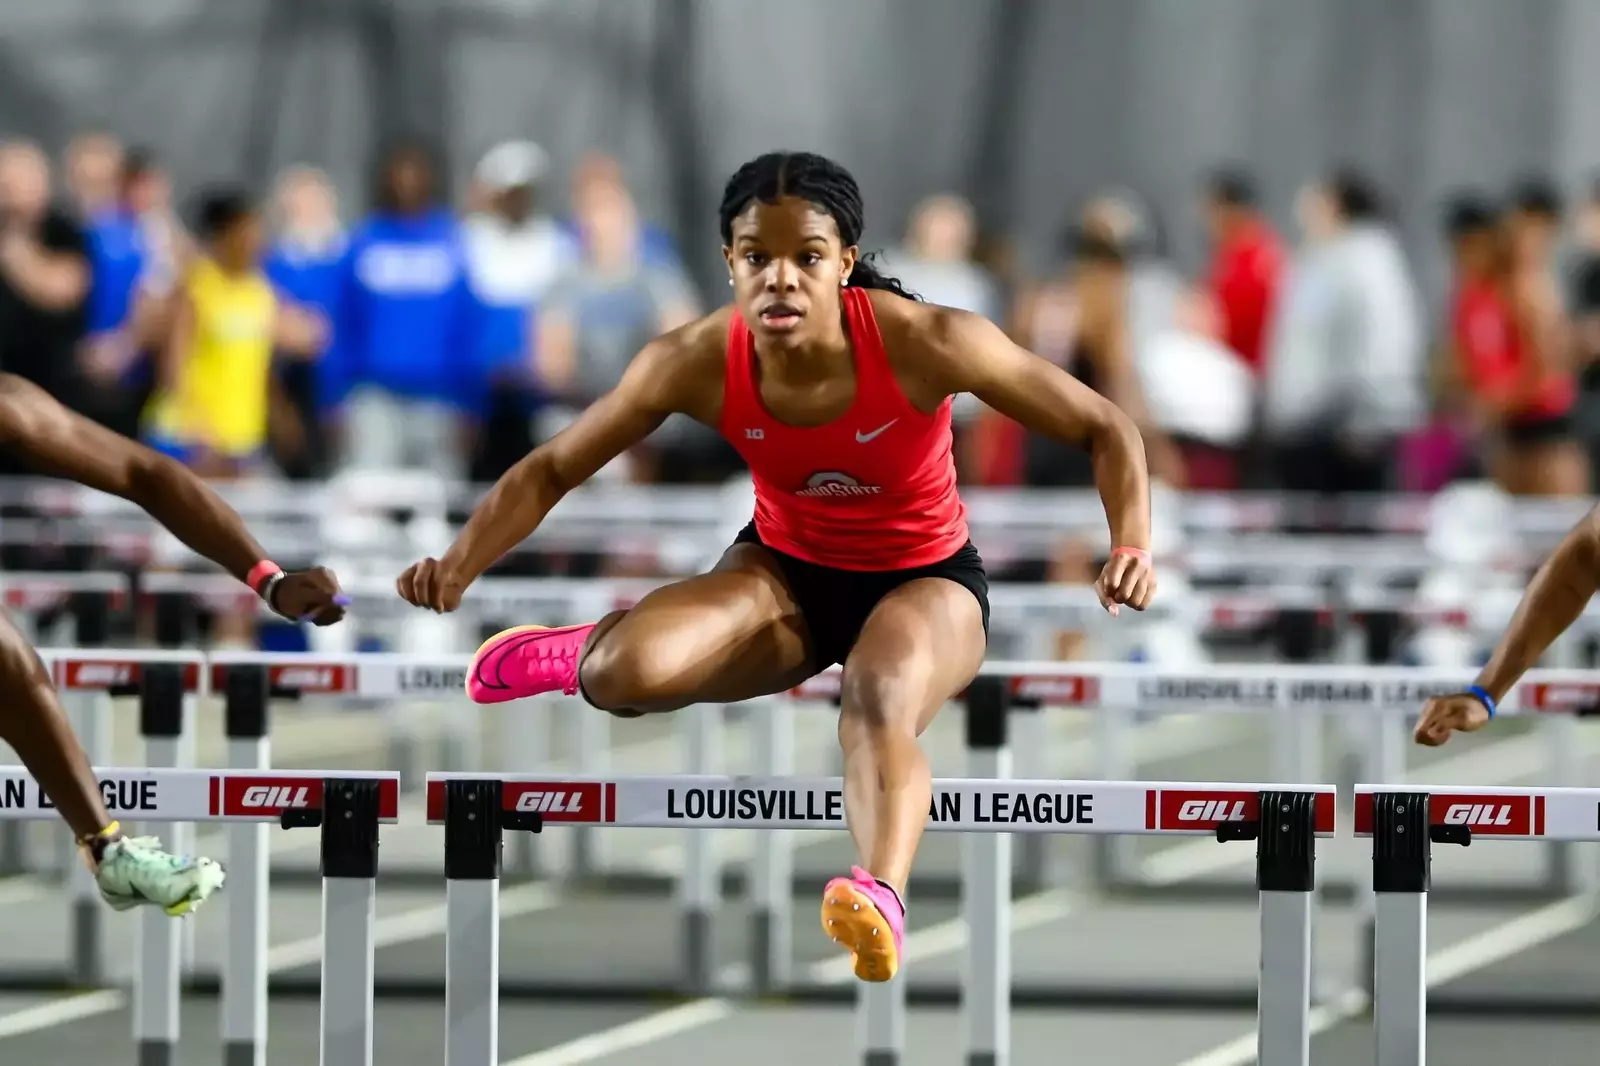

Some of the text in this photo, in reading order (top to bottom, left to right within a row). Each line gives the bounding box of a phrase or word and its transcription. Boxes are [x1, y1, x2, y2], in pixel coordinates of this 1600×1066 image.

[38, 780, 157, 810] LGUE
[241, 786, 309, 807] GILL
[515, 791, 583, 813] GILL
[668, 788, 842, 820] LOUISVILLE
[973, 792, 1094, 824] LEAGUE
[1178, 800, 1246, 821] GILL
[1443, 804, 1512, 826] GILL
